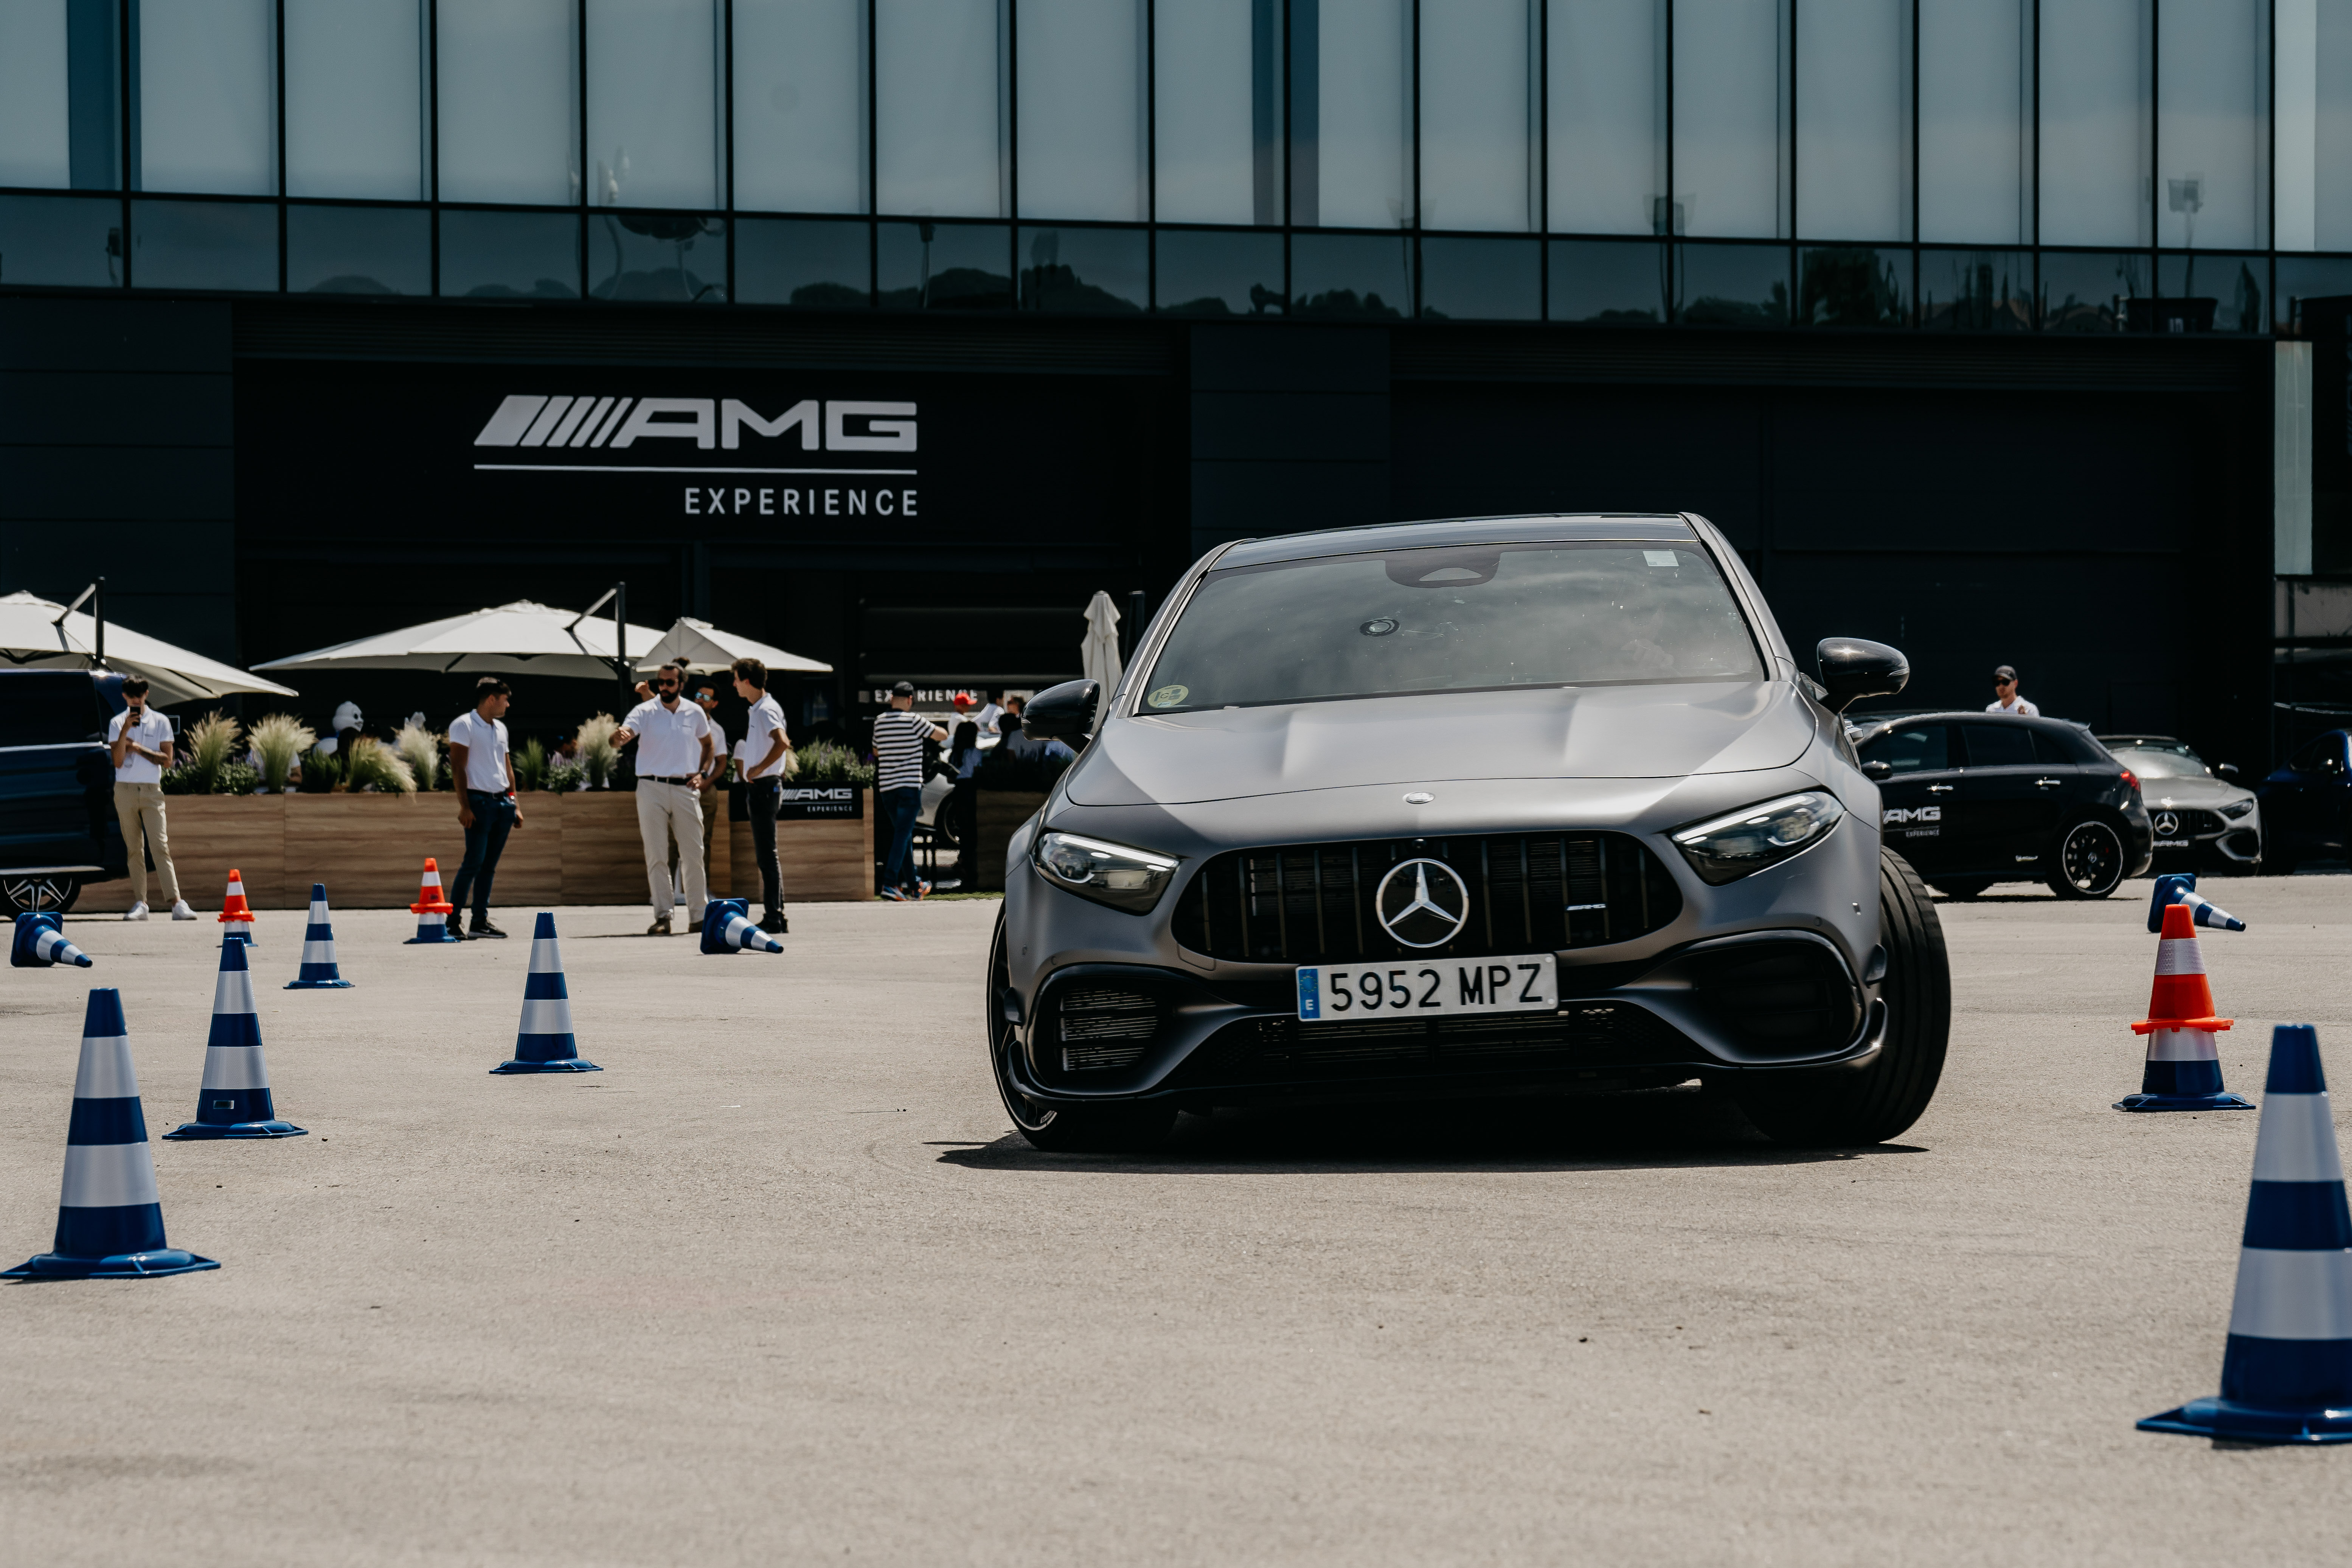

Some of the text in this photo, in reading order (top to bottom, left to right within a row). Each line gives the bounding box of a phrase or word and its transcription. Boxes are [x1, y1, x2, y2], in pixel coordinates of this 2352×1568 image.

[609, 397, 917, 452] AMG
[685, 487, 917, 516] EXPERIENCE
[874, 689, 978, 702] EXRIENE
[795, 788, 852, 800] AMG
[1883, 806, 1941, 824] AMG
[1330, 963, 1543, 1012] 5952 MPZ
[1305, 999, 1313, 1010] E
